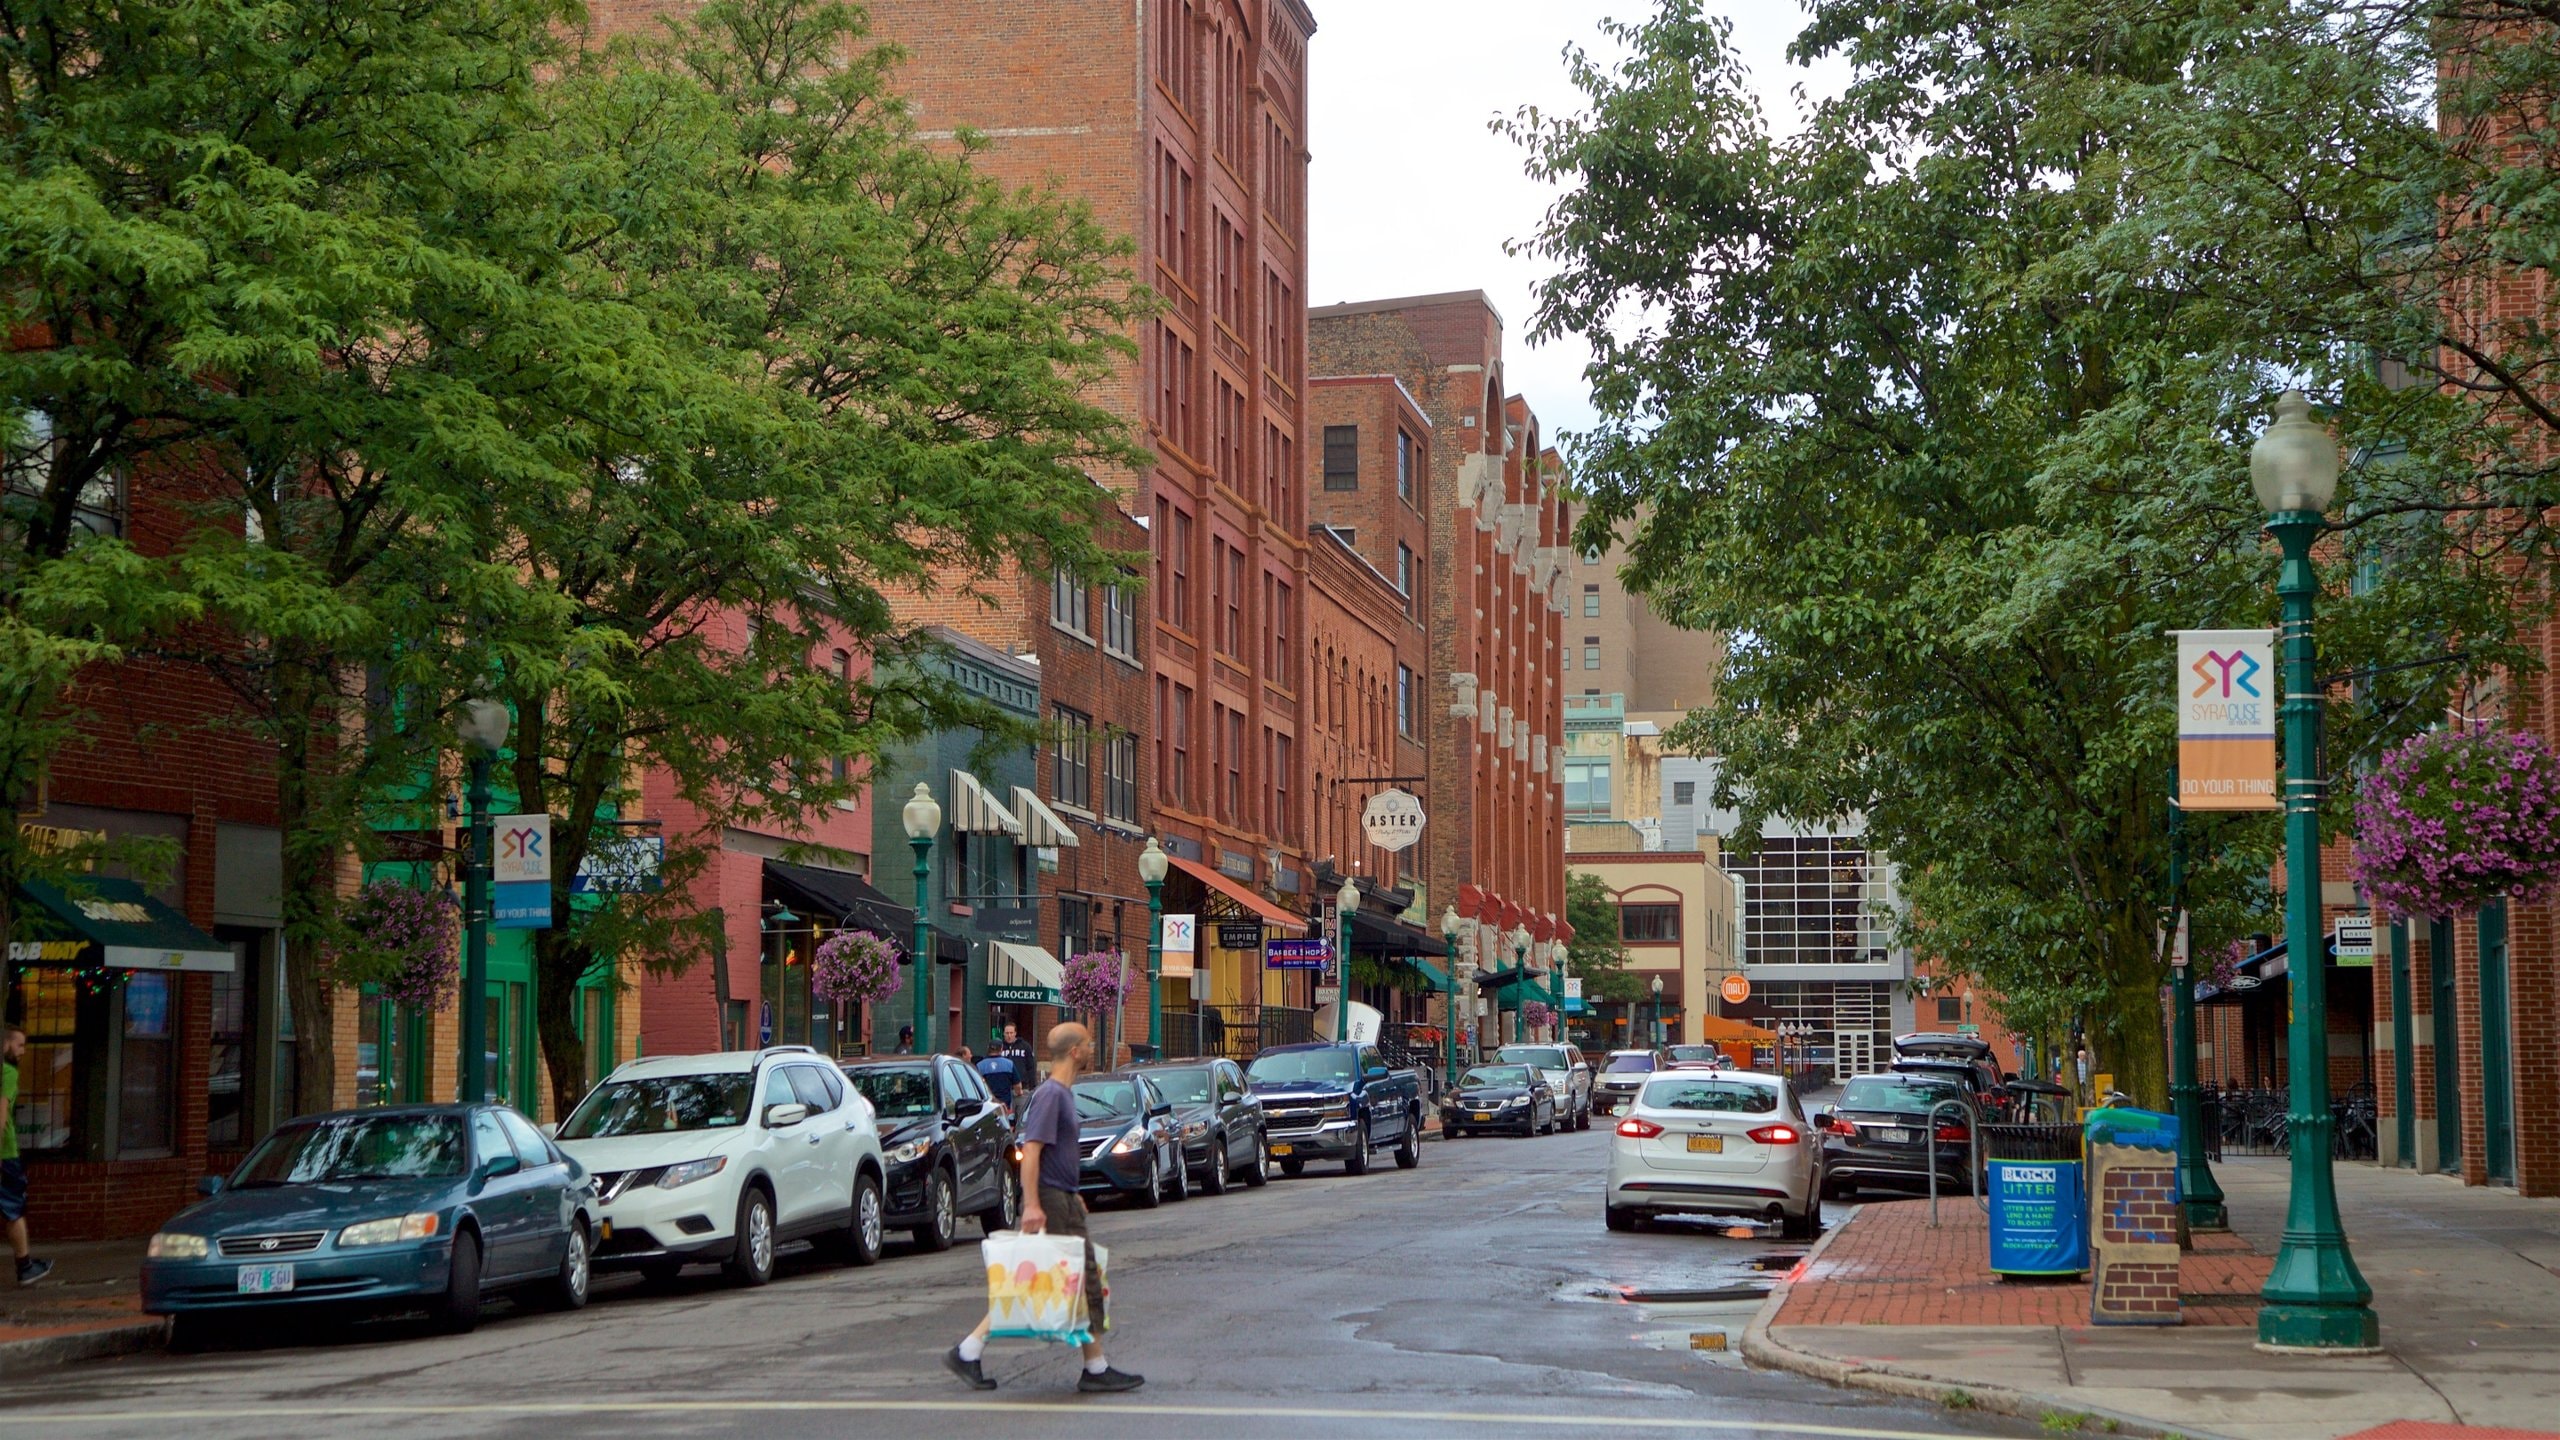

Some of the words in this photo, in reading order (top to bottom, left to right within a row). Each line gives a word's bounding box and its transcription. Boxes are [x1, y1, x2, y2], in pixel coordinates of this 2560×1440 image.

[2192, 650, 2261, 698] SYR
[2192, 703, 2262, 721] SYRACUSE
[2182, 779, 2198, 794] DO
[2202, 779, 2235, 794] YOUR
[2237, 779, 2274, 794] THING
[1370, 815, 1416, 827] ASTER
[502, 828, 543, 859] SYR
[495, 908, 506, 919] DO
[507, 908, 528, 918] YOUR
[529, 907, 551, 918] THING
[1168, 921, 1190, 938] SYR
[1223, 933, 1258, 941] EMPIRE
[9, 940, 91, 961] SUBWAY
[995, 989, 1043, 1001] GROCERY
[1725, 983, 1746, 995] MALT
[2003, 1168, 2055, 1181] BLOCK
[2003, 1184, 2056, 1195] LITTER
